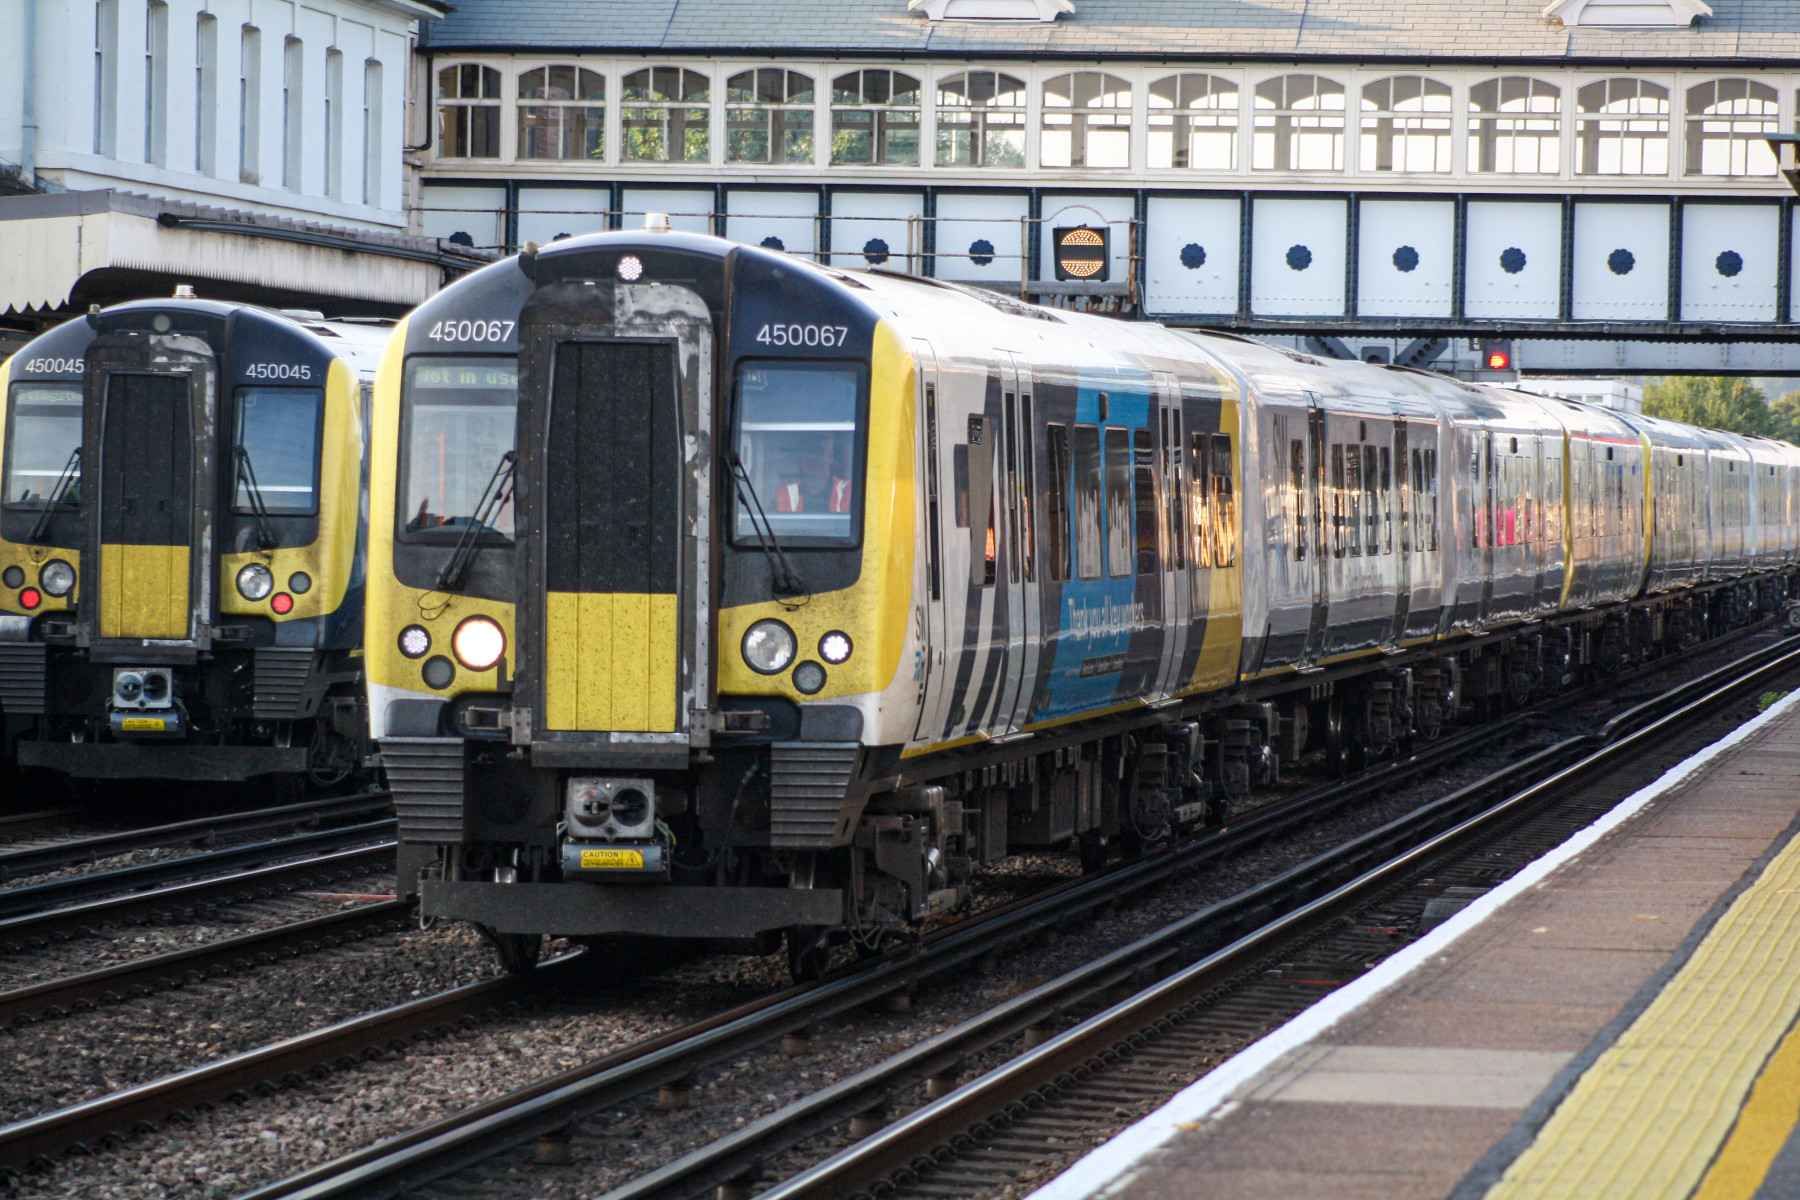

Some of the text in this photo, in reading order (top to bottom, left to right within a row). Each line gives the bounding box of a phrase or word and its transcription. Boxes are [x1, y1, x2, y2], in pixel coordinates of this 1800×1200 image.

[428, 320, 516, 342] 450067
[756, 324, 849, 347] 450067
[25, 358, 85, 374] 450045
[245, 363, 312, 380] 450045
[460, 370, 477, 385] in
[1067, 596, 1088, 642] Thank
[1088, 608, 1101, 652] you
[1109, 594, 1121, 647] key
[1120, 592, 1144, 633] workers
